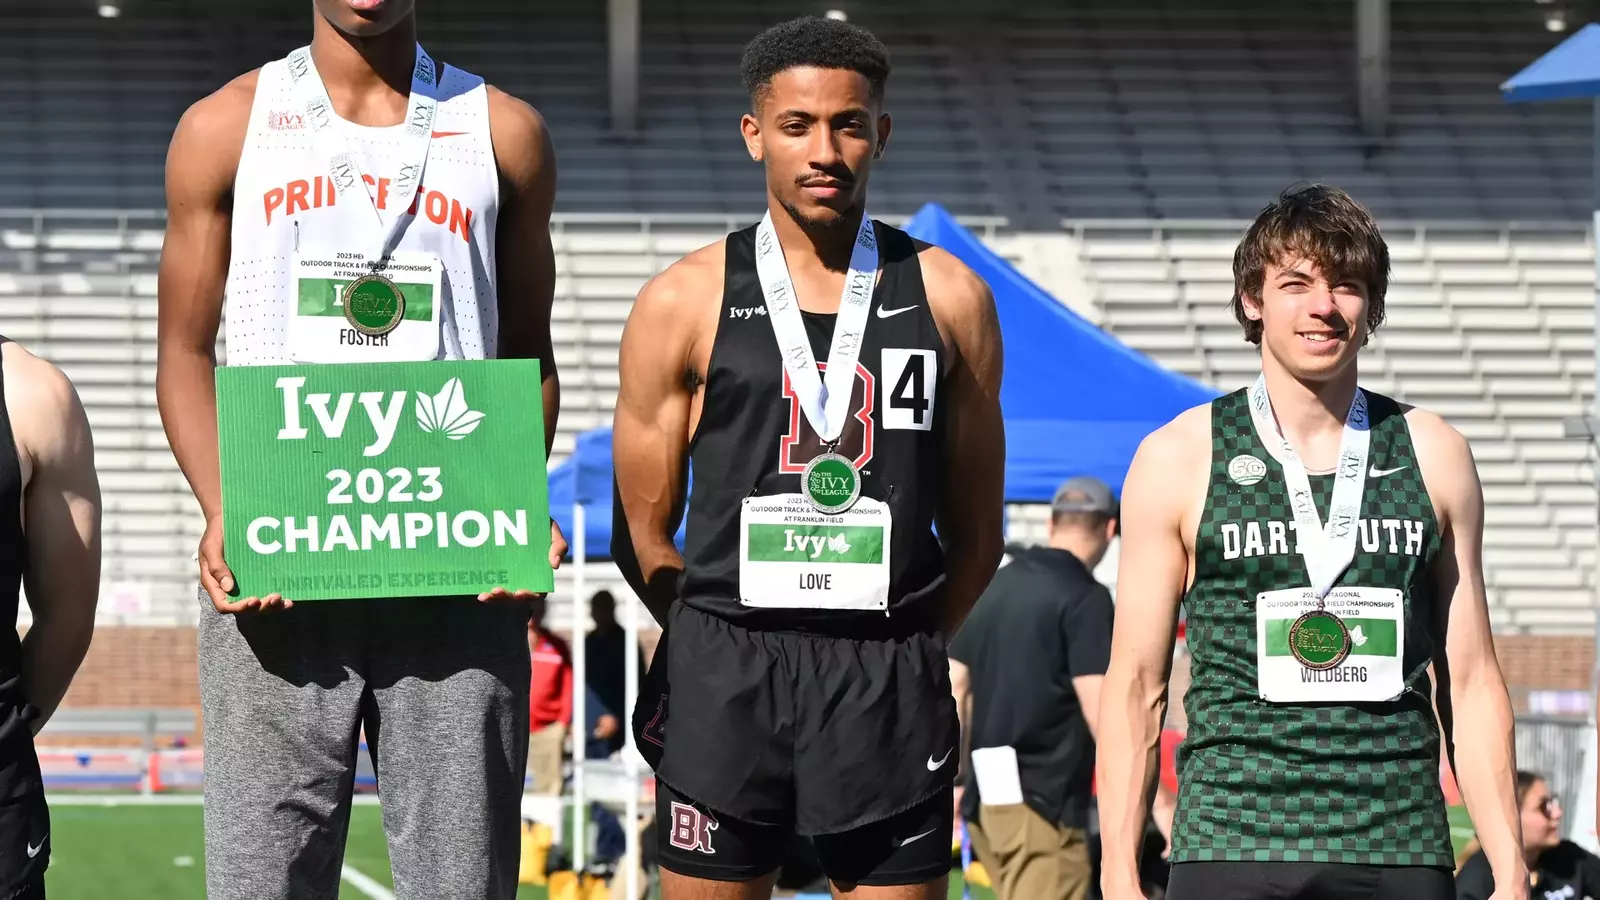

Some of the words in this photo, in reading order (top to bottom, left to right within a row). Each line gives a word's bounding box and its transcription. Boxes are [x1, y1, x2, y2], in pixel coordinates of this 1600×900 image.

[293, 56, 309, 78] IVY
[279, 115, 304, 125] IVY
[312, 104, 331, 129] IVY
[412, 102, 428, 128] IVY
[336, 163, 356, 189] IVY
[397, 162, 413, 188] IVY
[263, 174, 473, 243] PRIEON
[300, 260, 332, 268] OUTDOOR
[333, 261, 355, 269] TRACK
[336, 252, 352, 260] 2023
[353, 253, 396, 262] HENAL
[851, 269, 867, 297] IVY
[729, 306, 754, 320] Ivy
[838, 328, 853, 356] IVY
[890, 354, 929, 424] 4
[273, 376, 407, 457] Ivy
[1345, 456, 1360, 483] IVY
[324, 466, 443, 504] 2023
[821, 477, 849, 489] IVY
[793, 515, 825, 523] FRANKLIN
[825, 516, 844, 524] FIELD
[844, 504, 882, 515] PIONSHIPS
[246, 509, 528, 555] CHAMPION
[1220, 518, 1424, 560] DARTUTH
[1336, 515, 1351, 540] IVY
[784, 529, 827, 559] Ivy
[273, 573, 382, 592] UNRIVALED
[387, 569, 509, 588] EXPERIENCE
[799, 573, 832, 590] LOVE
[1266, 600, 1299, 608] OUTDOOR
[1299, 600, 1317, 608] TRAC
[1346, 600, 1395, 609] CHAMPIONSHIPS
[1309, 633, 1338, 646] IVY
[1300, 666, 1368, 683] WILDBERG
